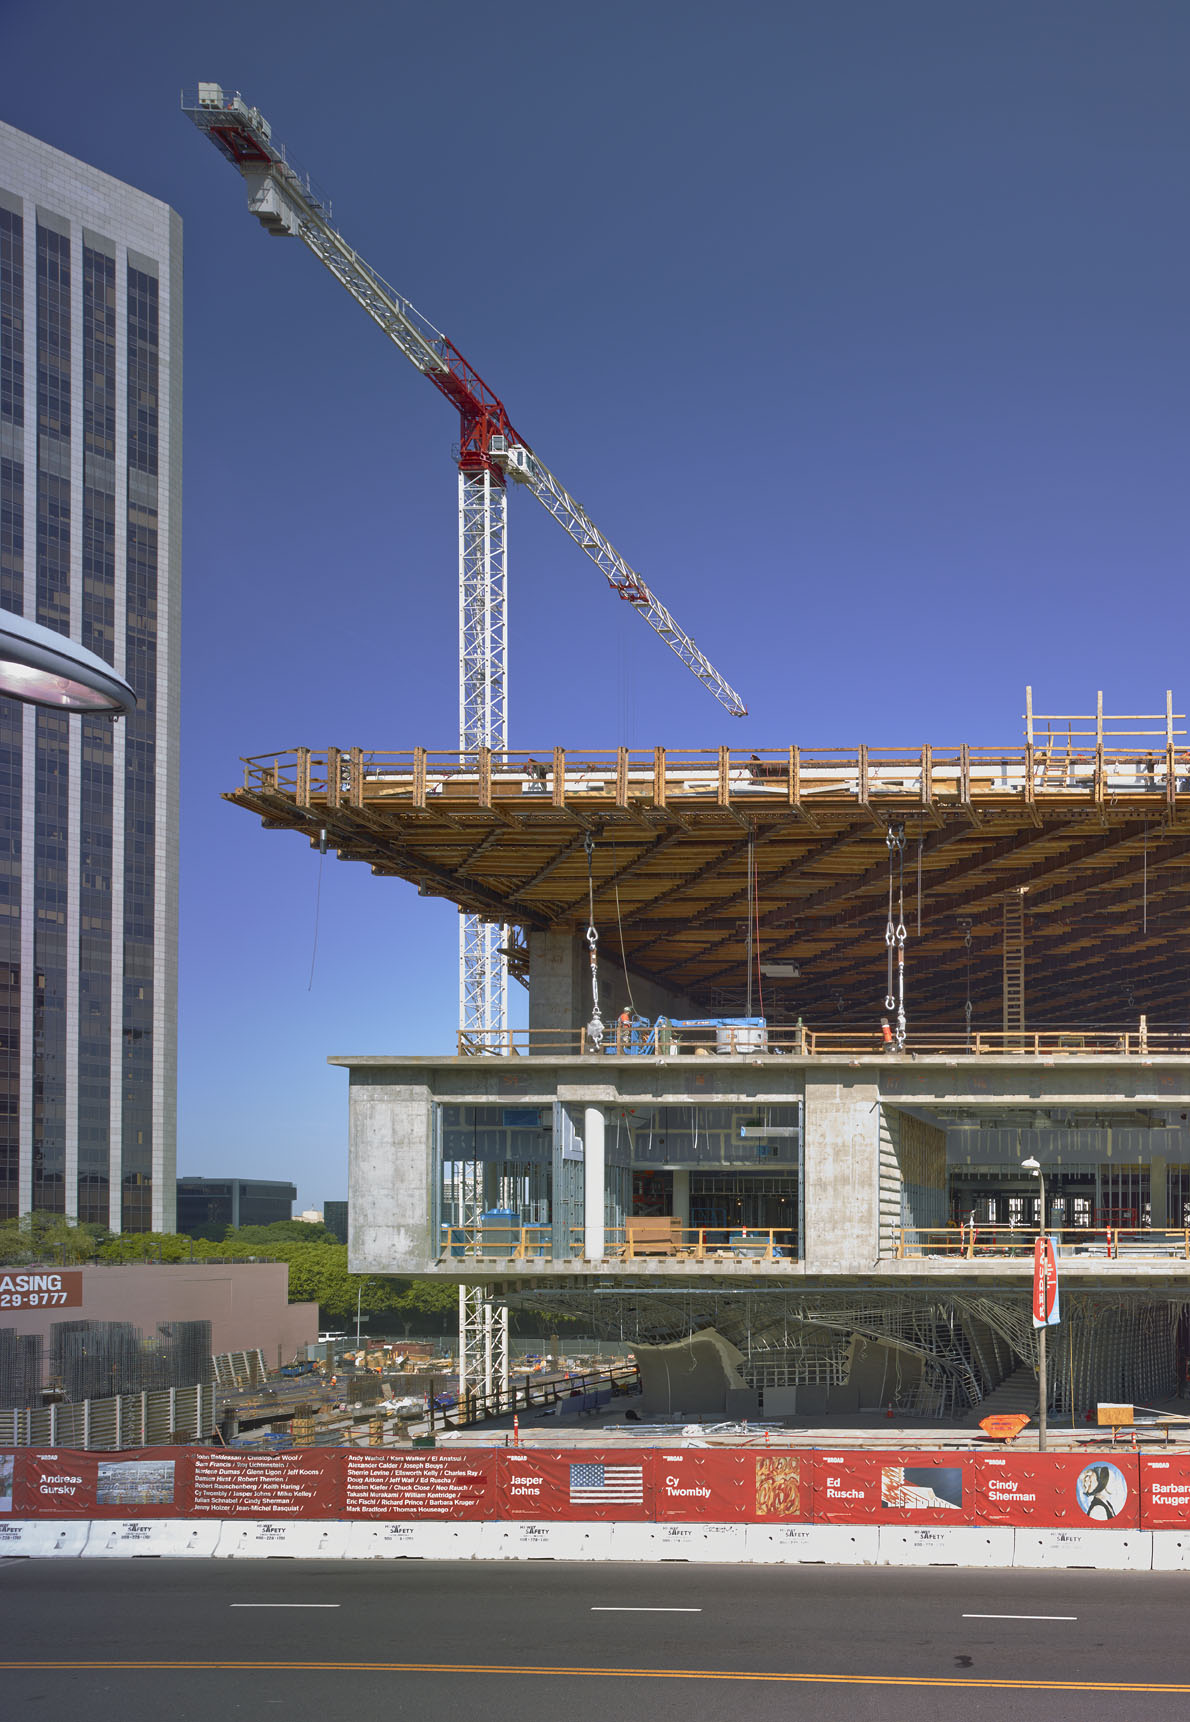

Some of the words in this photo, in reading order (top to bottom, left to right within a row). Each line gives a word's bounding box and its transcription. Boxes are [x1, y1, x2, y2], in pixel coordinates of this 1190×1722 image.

[0, 1275, 62, 1292] ASING
[0, 1292, 68, 1307] 29-9777
[40, 1475, 82, 1484] Andreas
[510, 1476, 543, 1486] Jasper
[666, 1476, 679, 1487] Cy
[827, 1478, 841, 1487] Ed
[40, 1485, 76, 1495] Gursky
[989, 1480, 1018, 1491] Cindy
[510, 1487, 540, 1496] Johns
[665, 1487, 711, 1498] Twombly
[827, 1489, 865, 1499] Ruscha
[988, 1491, 1036, 1501] Sherman
[1152, 1495, 1190, 1506] Kruger
